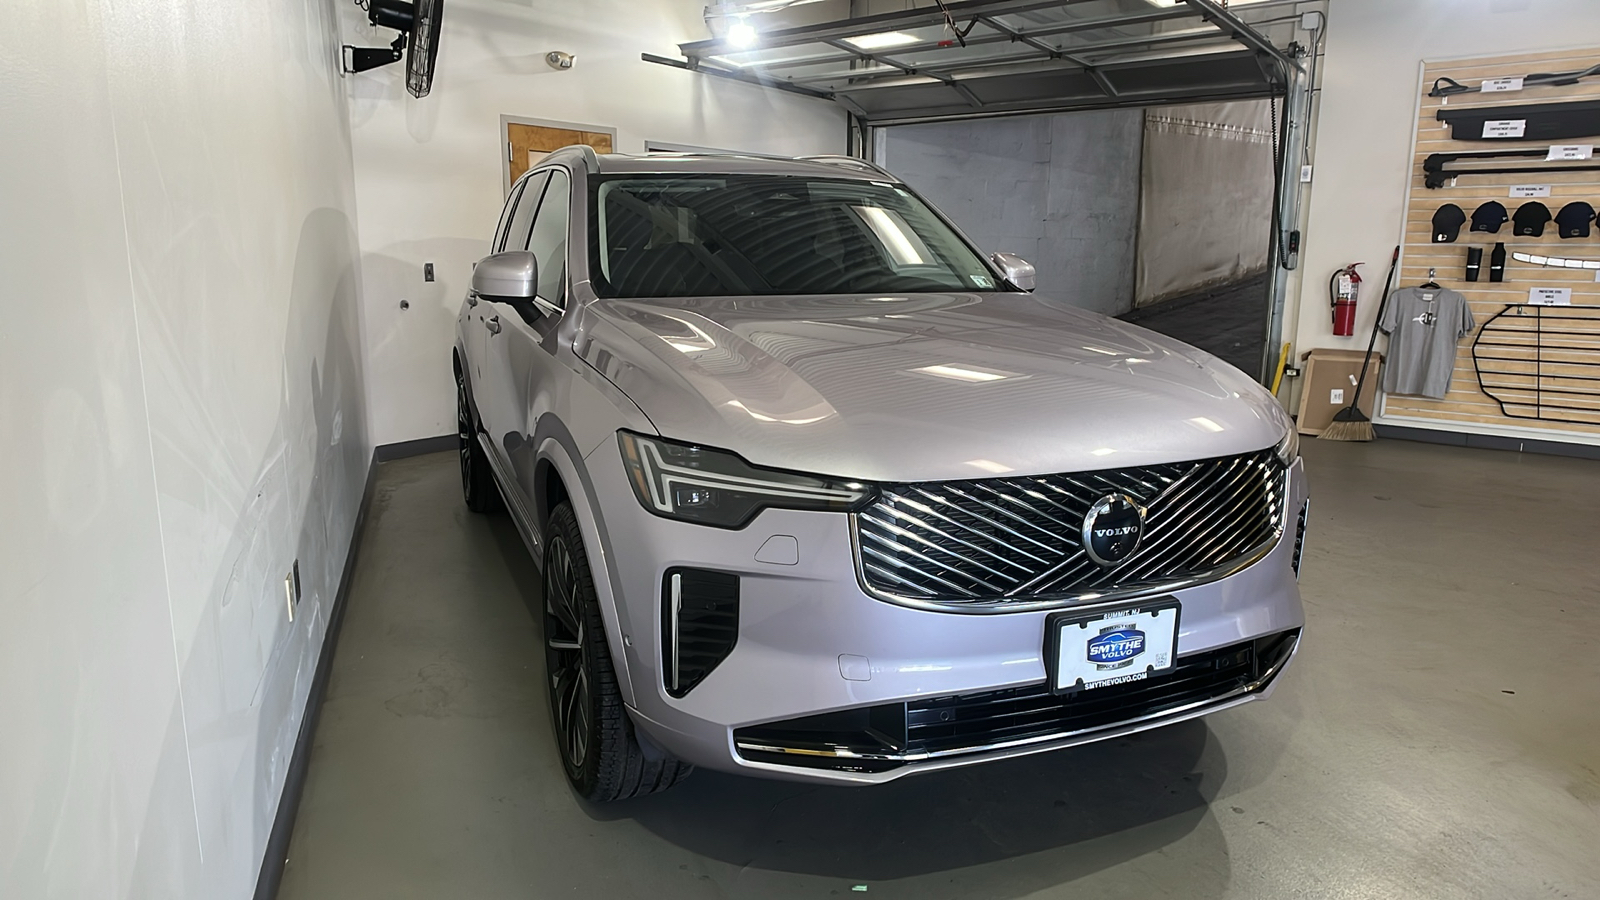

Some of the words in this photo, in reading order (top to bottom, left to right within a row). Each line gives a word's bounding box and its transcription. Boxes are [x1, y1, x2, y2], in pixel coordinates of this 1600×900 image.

[1094, 526, 1138, 537] VOLVO
[1131, 608, 1140, 616] NJ
[1090, 640, 1142, 656] SMYTHE
[1101, 649, 1133, 659] VOLVO
[1084, 672, 1148, 690] SMYTHEVOLVO.COM
